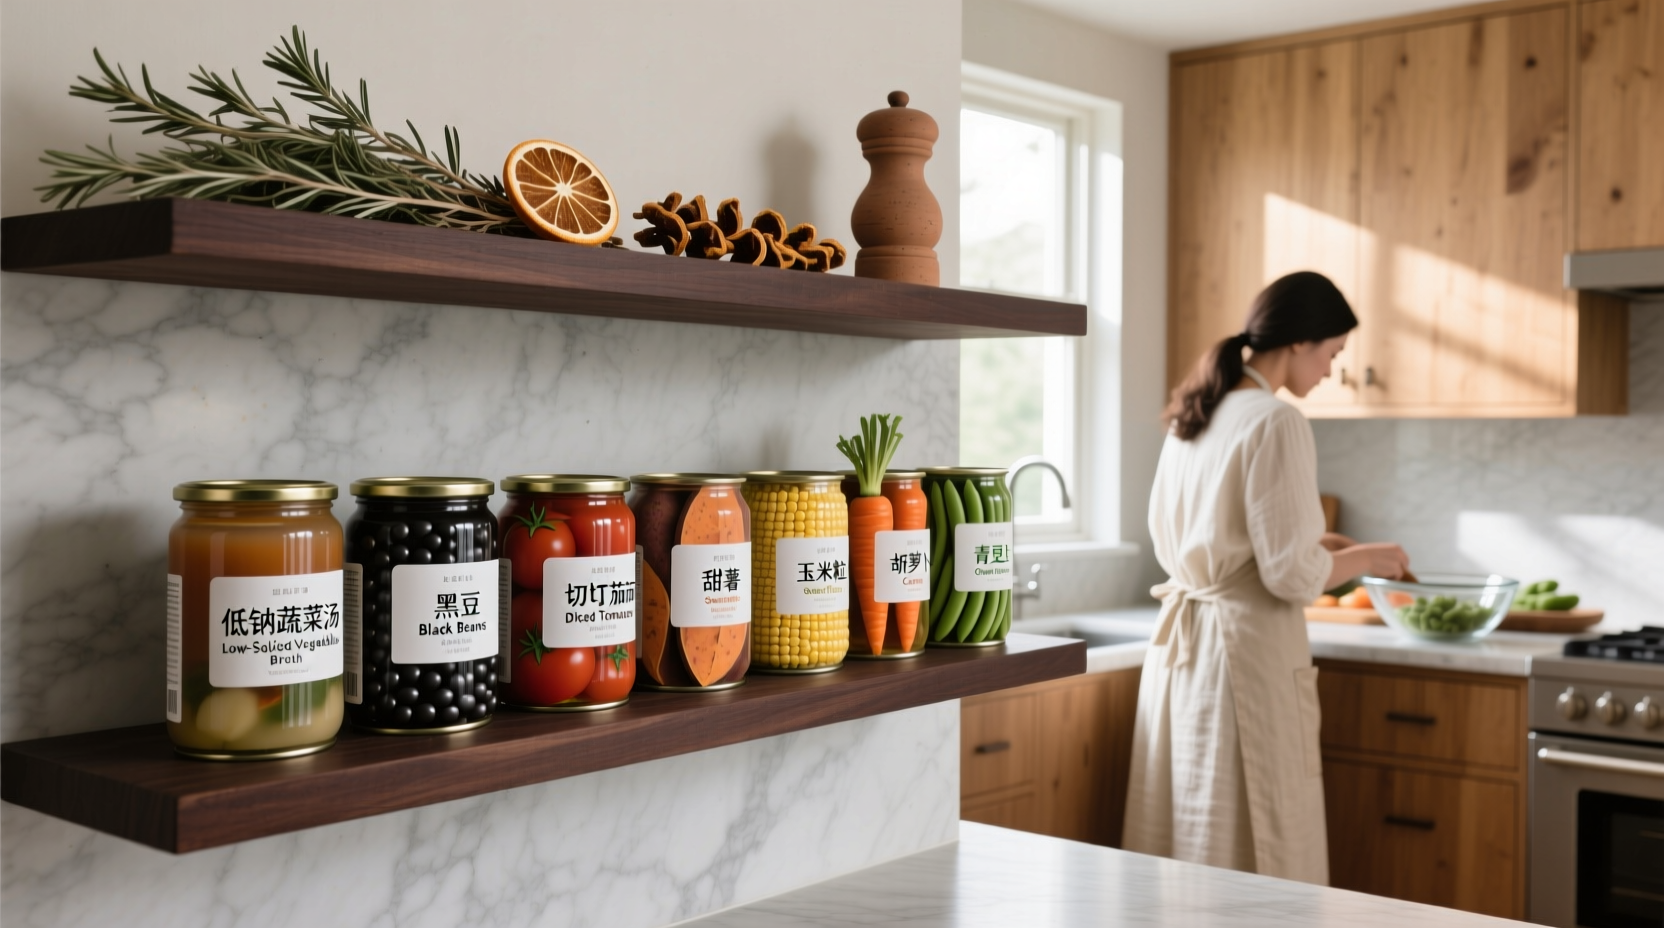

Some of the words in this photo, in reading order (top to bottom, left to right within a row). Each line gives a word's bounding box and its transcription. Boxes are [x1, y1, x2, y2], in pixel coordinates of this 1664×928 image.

[702, 568, 741, 592] 甜薯
[797, 559, 847, 583] 玉米粒
[434, 591, 480, 619] 黑豆
[221, 602, 340, 637] 低钠蔬菜汤
[419, 622, 453, 636] Black
[457, 621, 487, 633] Beans
[565, 612, 595, 623] Diced
[270, 653, 303, 666] Broth
